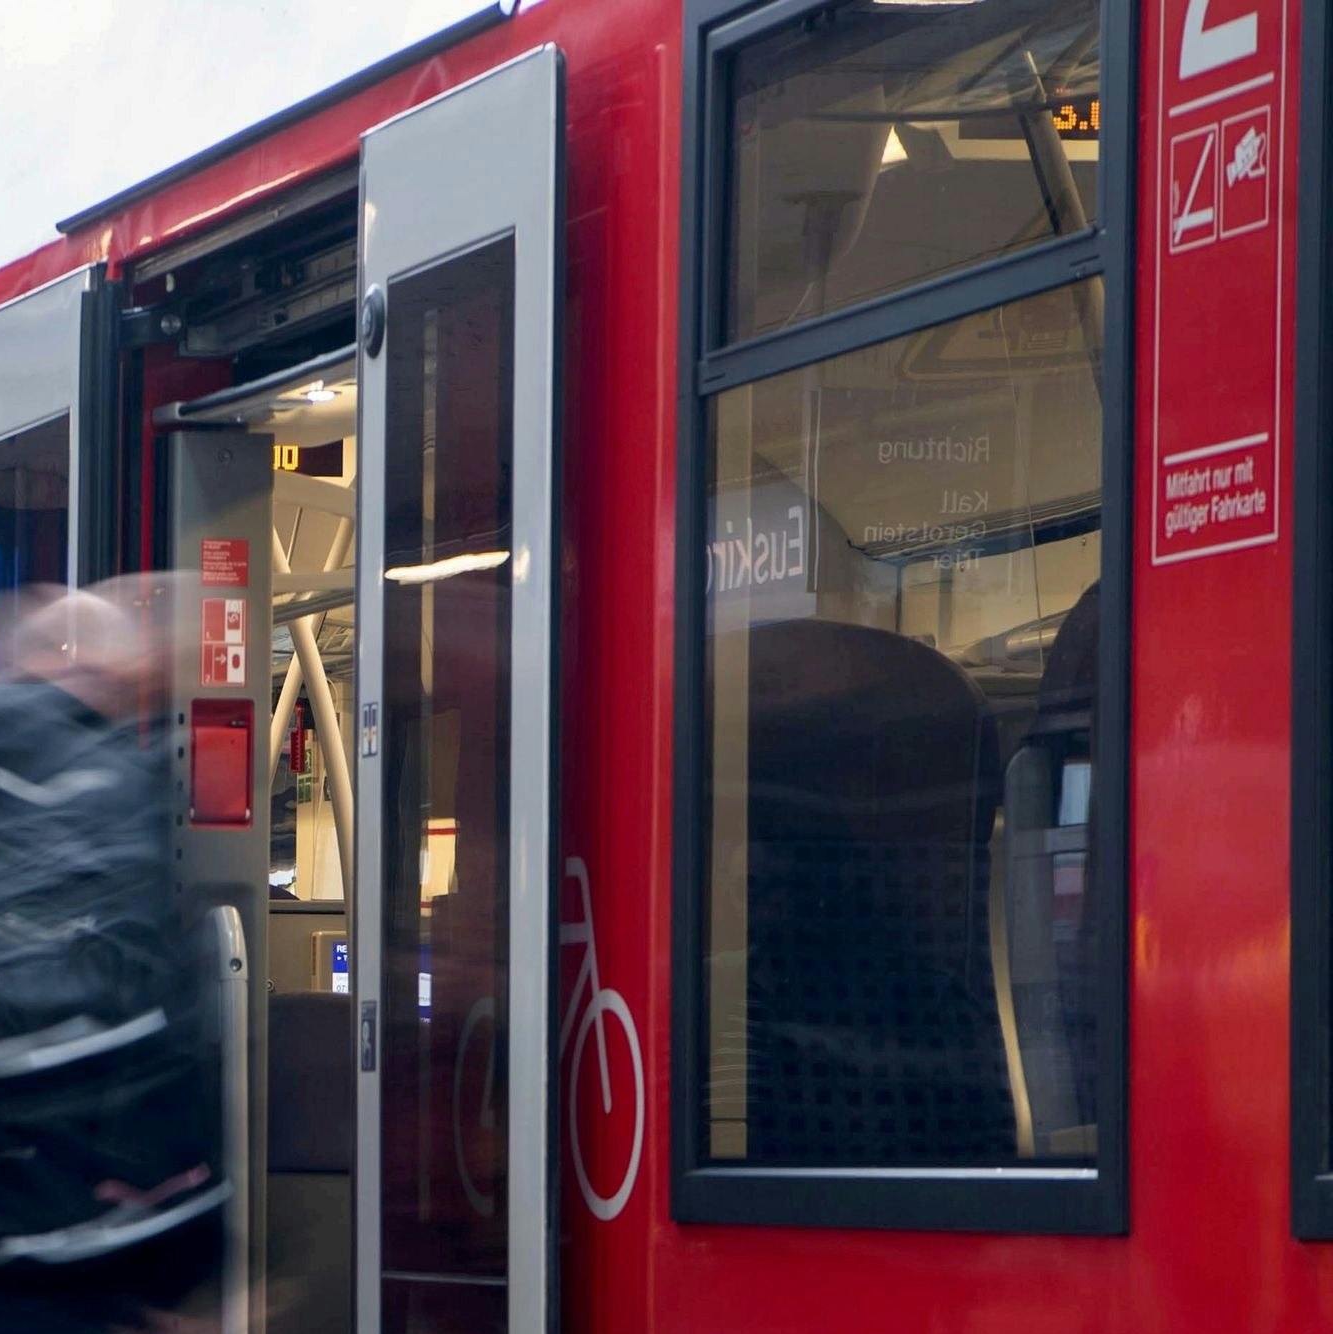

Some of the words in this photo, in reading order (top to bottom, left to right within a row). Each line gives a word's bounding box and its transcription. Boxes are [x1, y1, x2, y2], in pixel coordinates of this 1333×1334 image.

[1166, 468, 1210, 499] Mitfahrt
[1213, 466, 1232, 489] nur
[1234, 456, 1254, 485] mit
[1165, 502, 1209, 538] gültiger
[1211, 488, 1267, 523] Fahrkarte
